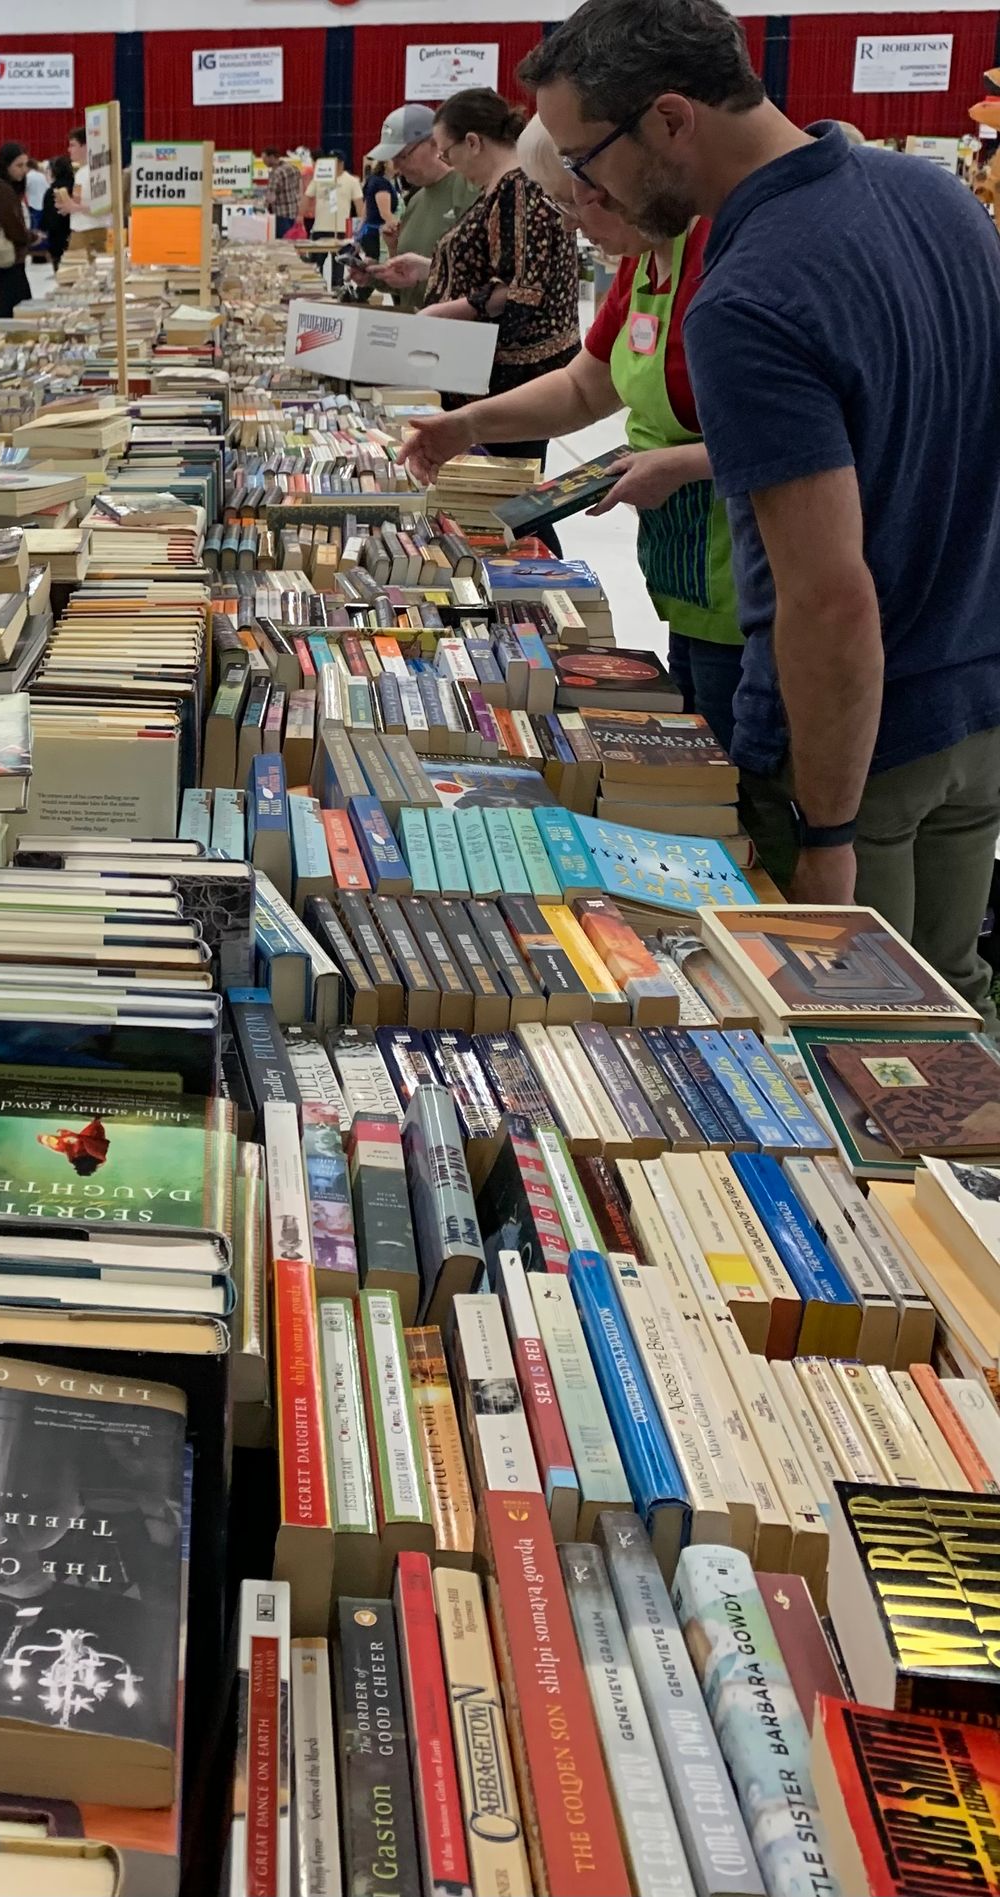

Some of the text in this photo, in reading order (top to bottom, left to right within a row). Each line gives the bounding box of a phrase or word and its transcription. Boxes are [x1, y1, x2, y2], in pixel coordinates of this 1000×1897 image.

[8, 69, 70, 79] LOCK & SAFE
[198, 54, 216, 70] IG
[881, 42, 949, 53] ROBERTSON
[136, 184, 186, 199] Fiction
[213, 164, 250, 175] istorical
[213, 177, 237, 185] ction
[791, 1000, 960, 1016] FAMOUS LAST WORDS
[243, 1013, 290, 1101] Findley PILGRIM
[57, 1103, 129, 1118] somaya
[135, 1108, 191, 1123] shilpi
[34, 1373, 152, 1401] LINDA
[522, 1338, 553, 1403] SEX IS RED
[288, 1285, 313, 1518] SECRET DAUGHTER shilpi somaya gowda
[380, 1354, 413, 1502] JESSICA GRANT Come, Thou Tortoise
[636, 1317, 715, 1497] MAVIS GALLANT ACROSS THE BRIDGE
[687, 1393, 724, 1456] Mavis Gallant
[330, 1362, 357, 1512] JESSICA GRANT Come, Thou Tortoise
[4, 1512, 113, 1537] THEIR
[43, 1562, 113, 1583] THE
[848, 1496, 990, 1670] WILBUR
[634, 1575, 684, 1696] GENEVIEVE GRAHAM
[253, 1651, 263, 1693] SANDRA
[265, 1650, 276, 1697] GULLAND
[369, 1641, 393, 1755] GOOD CHEER
[589, 1611, 635, 1739] GENEVIEVE GRAHAM
[351, 1665, 373, 1753] The ORDER of
[511, 1538, 596, 1870] THE GOLDEN SON shilpi somaya gowda
[256, 1717, 269, 1755] EARTH
[447, 1676, 522, 1847] CABBAGETOWN
[716, 1590, 835, 1895] TLE SISTER BARBARA GOWDY
[852, 1712, 960, 1808] SMITH
[256, 1759, 268, 1780] ON
[665, 1709, 749, 1873] COME FROM AWAY
[256, 1785, 268, 1827] DANCE
[367, 1785, 398, 1879] Gaston
[255, 1832, 268, 1876] GREAT
